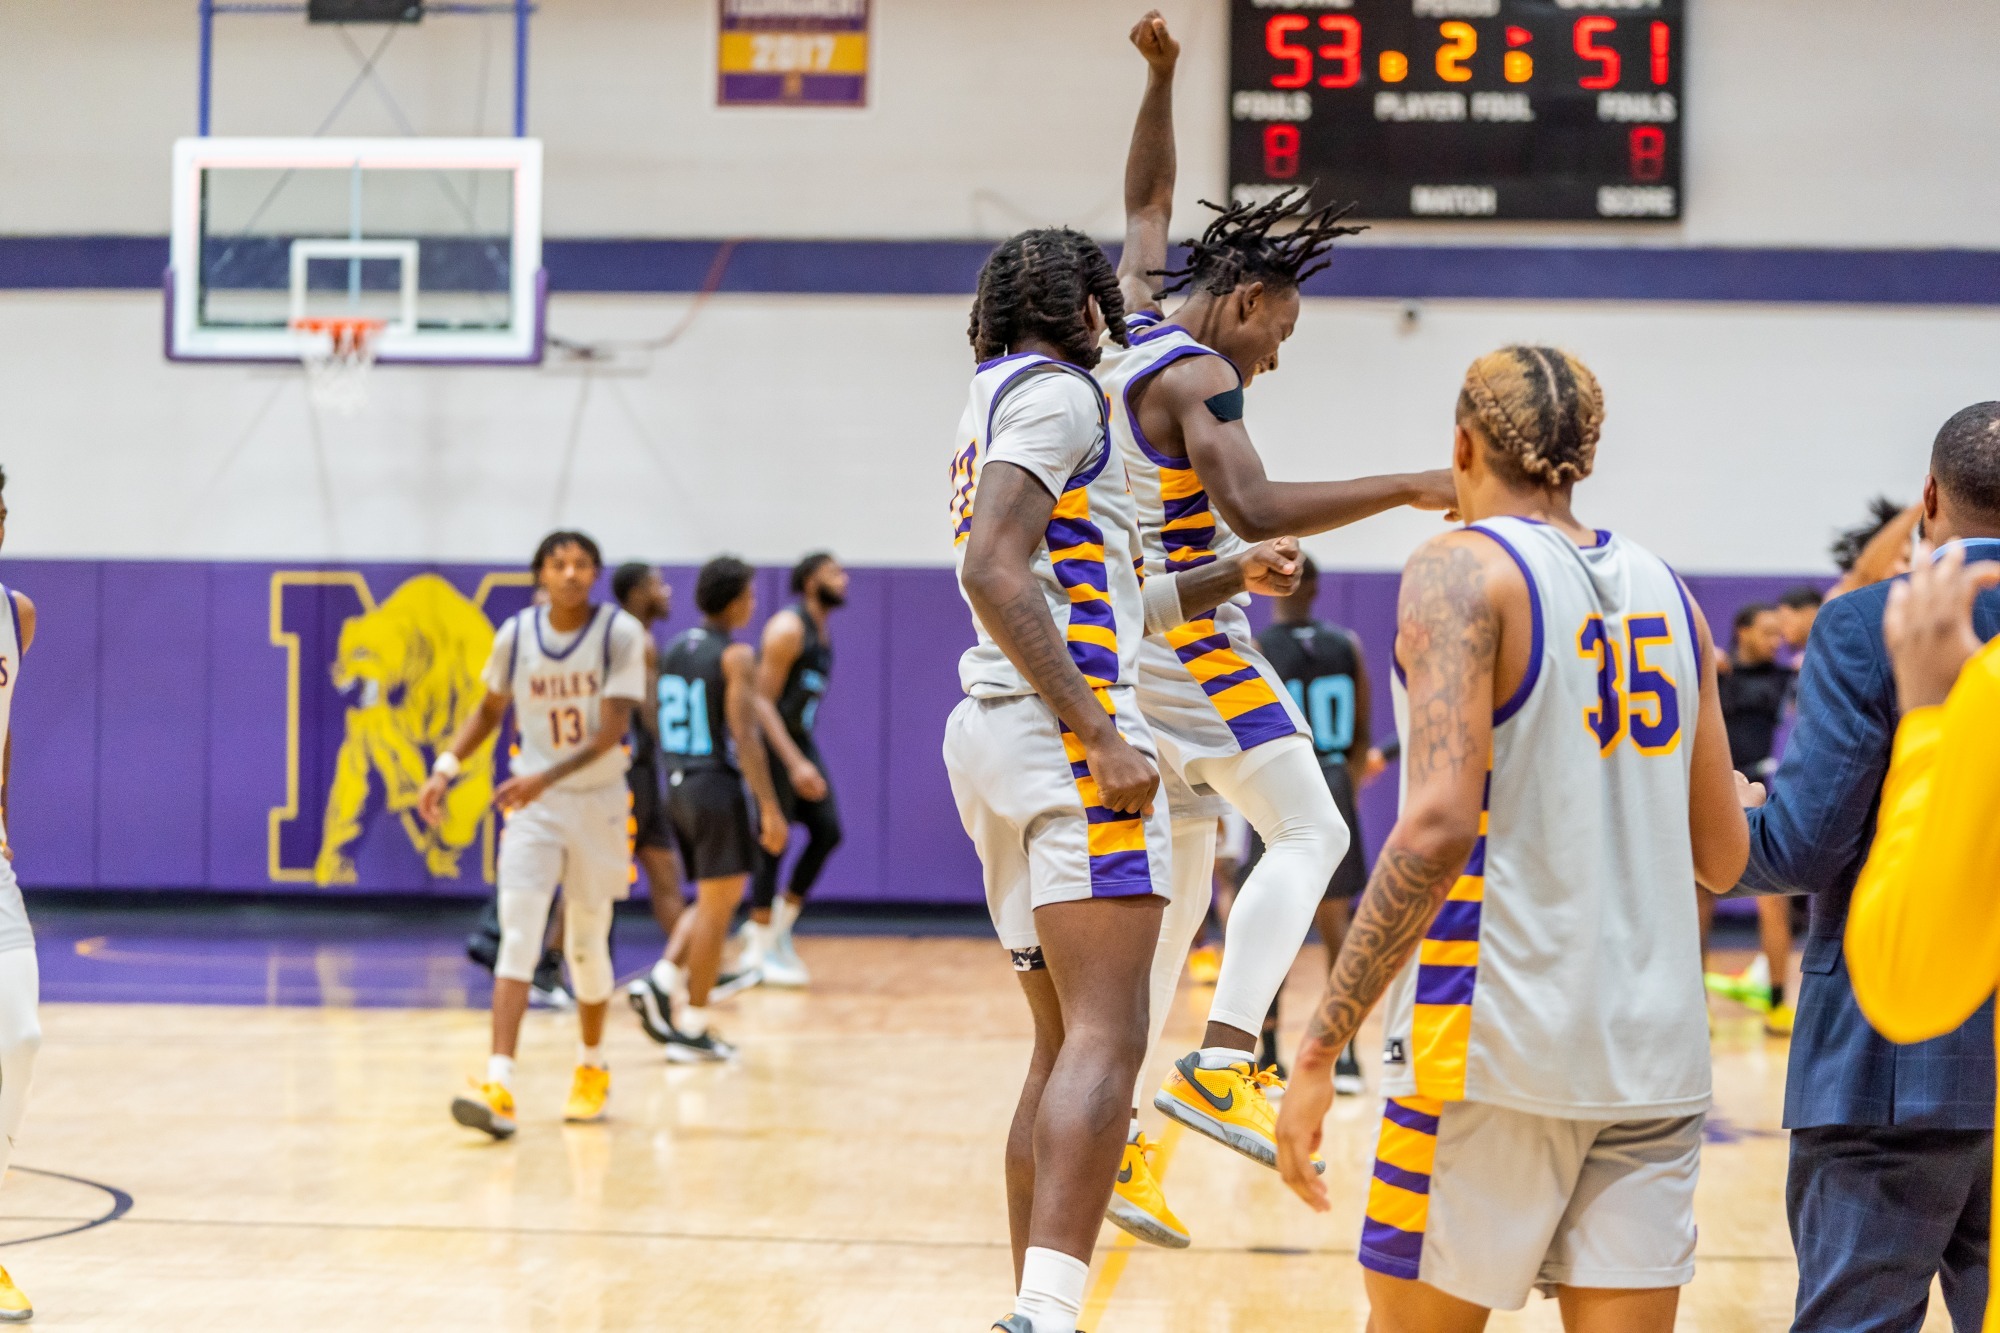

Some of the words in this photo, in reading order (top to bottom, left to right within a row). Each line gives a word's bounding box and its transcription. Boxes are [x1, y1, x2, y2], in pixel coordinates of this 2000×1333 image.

[1265, 14, 1362, 88] 53
[1436, 21, 1478, 82] 2
[1574, 15, 1669, 89] 51
[658, 672, 713, 756] 21
[1575, 612, 1681, 758] 35
[550, 706, 583, 748] 13
